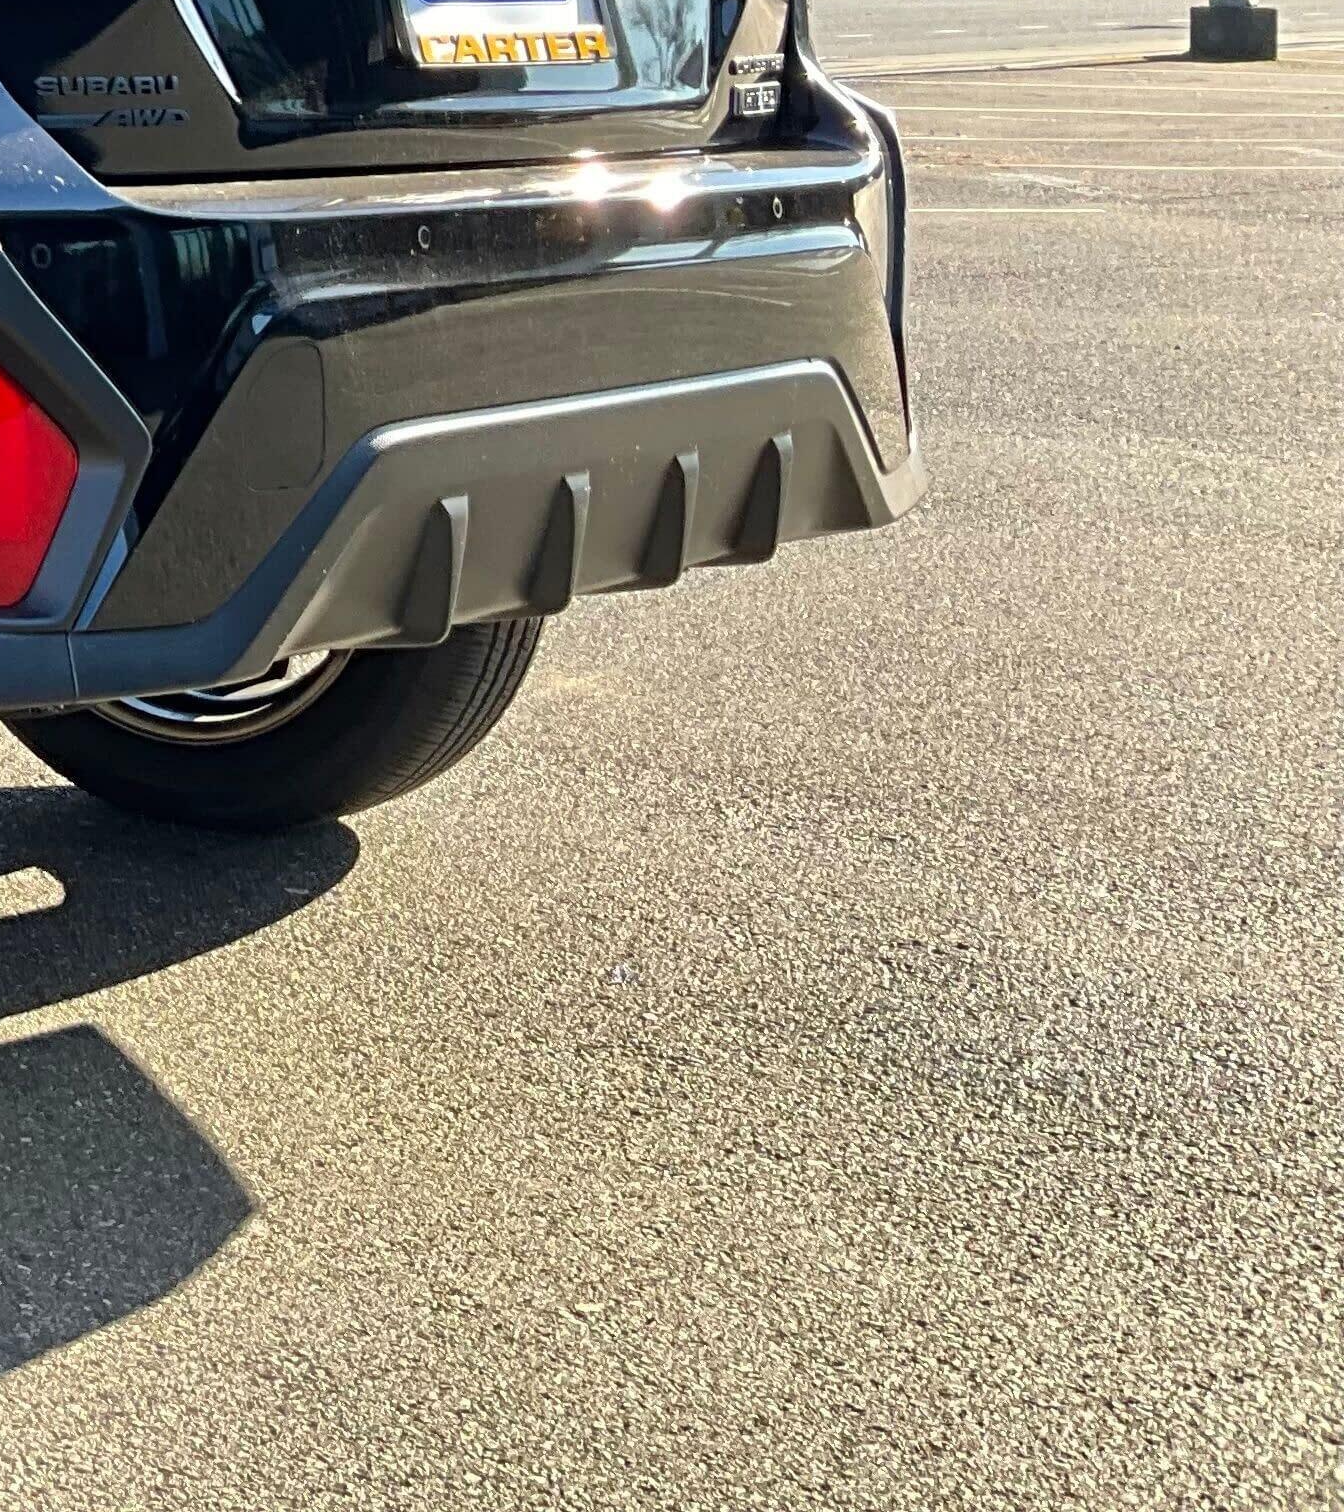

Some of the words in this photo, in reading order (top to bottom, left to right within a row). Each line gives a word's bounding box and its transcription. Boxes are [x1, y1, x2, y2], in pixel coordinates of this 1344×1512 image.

[417, 31, 610, 64] CARTER
[33, 75, 179, 96] SUBARU
[100, 108, 191, 127] AWD
